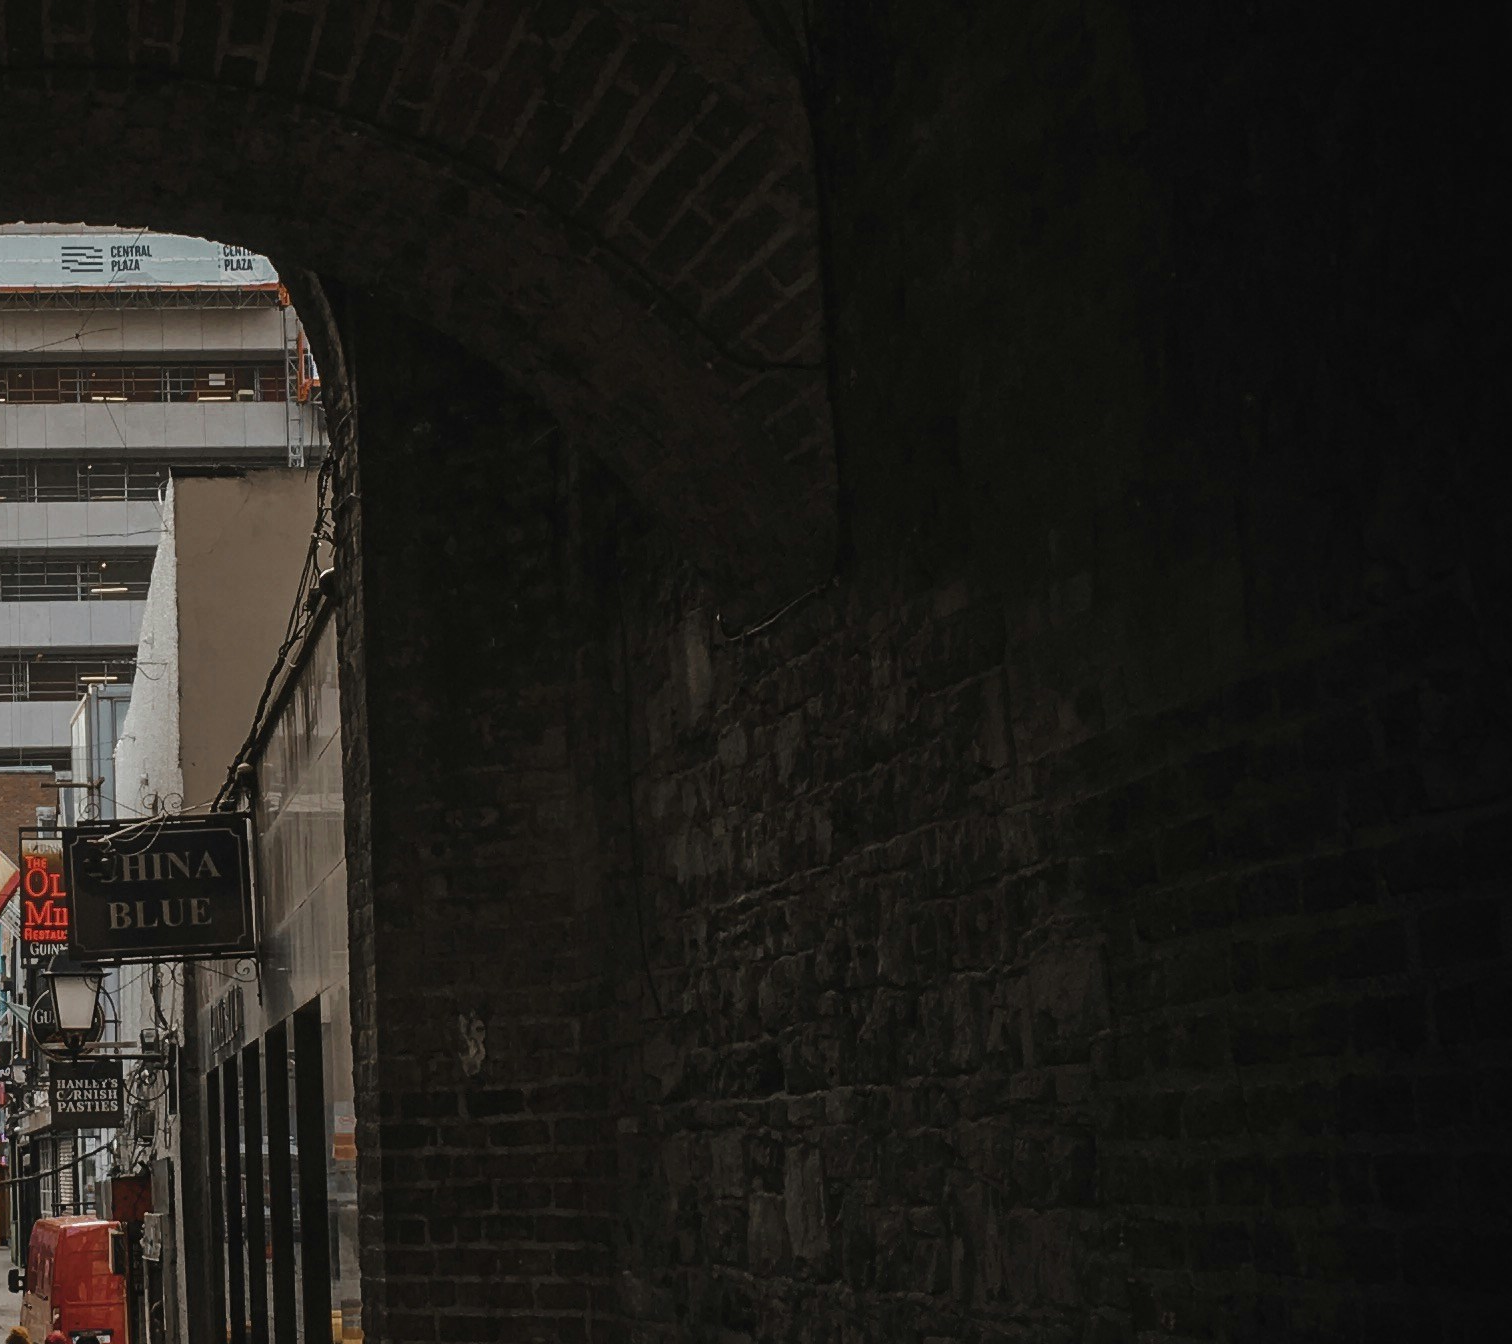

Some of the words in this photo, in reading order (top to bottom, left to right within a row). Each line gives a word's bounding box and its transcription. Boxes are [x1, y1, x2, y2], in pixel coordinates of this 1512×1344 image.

[110, 245, 153, 258] CENTRAL
[111, 259, 141, 271] PLAZA
[224, 259, 253, 271] PLAZA
[24, 856, 47, 869] THE
[107, 898, 212, 929] BLUE
[56, 1078, 118, 1089] HANLEY'S
[57, 1101, 118, 1113] PASTIES
